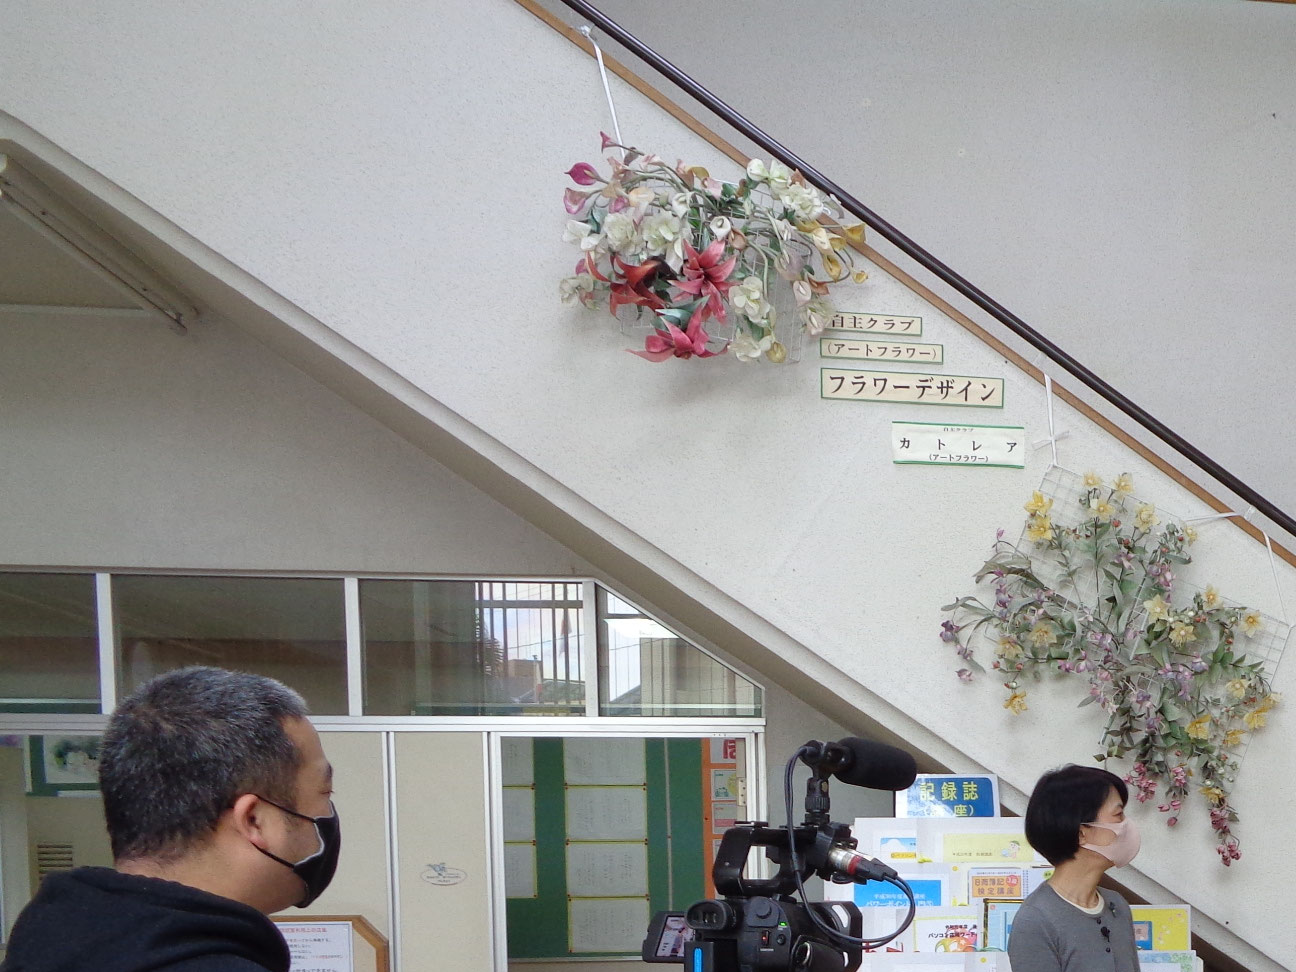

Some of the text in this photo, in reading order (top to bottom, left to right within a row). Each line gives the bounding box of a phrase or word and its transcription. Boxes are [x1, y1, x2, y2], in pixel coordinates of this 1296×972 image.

[832, 314, 914, 331] 自主クラブ
[829, 375, 996, 402] フラワーデザイン
[919, 780, 980, 802] 記録誌
